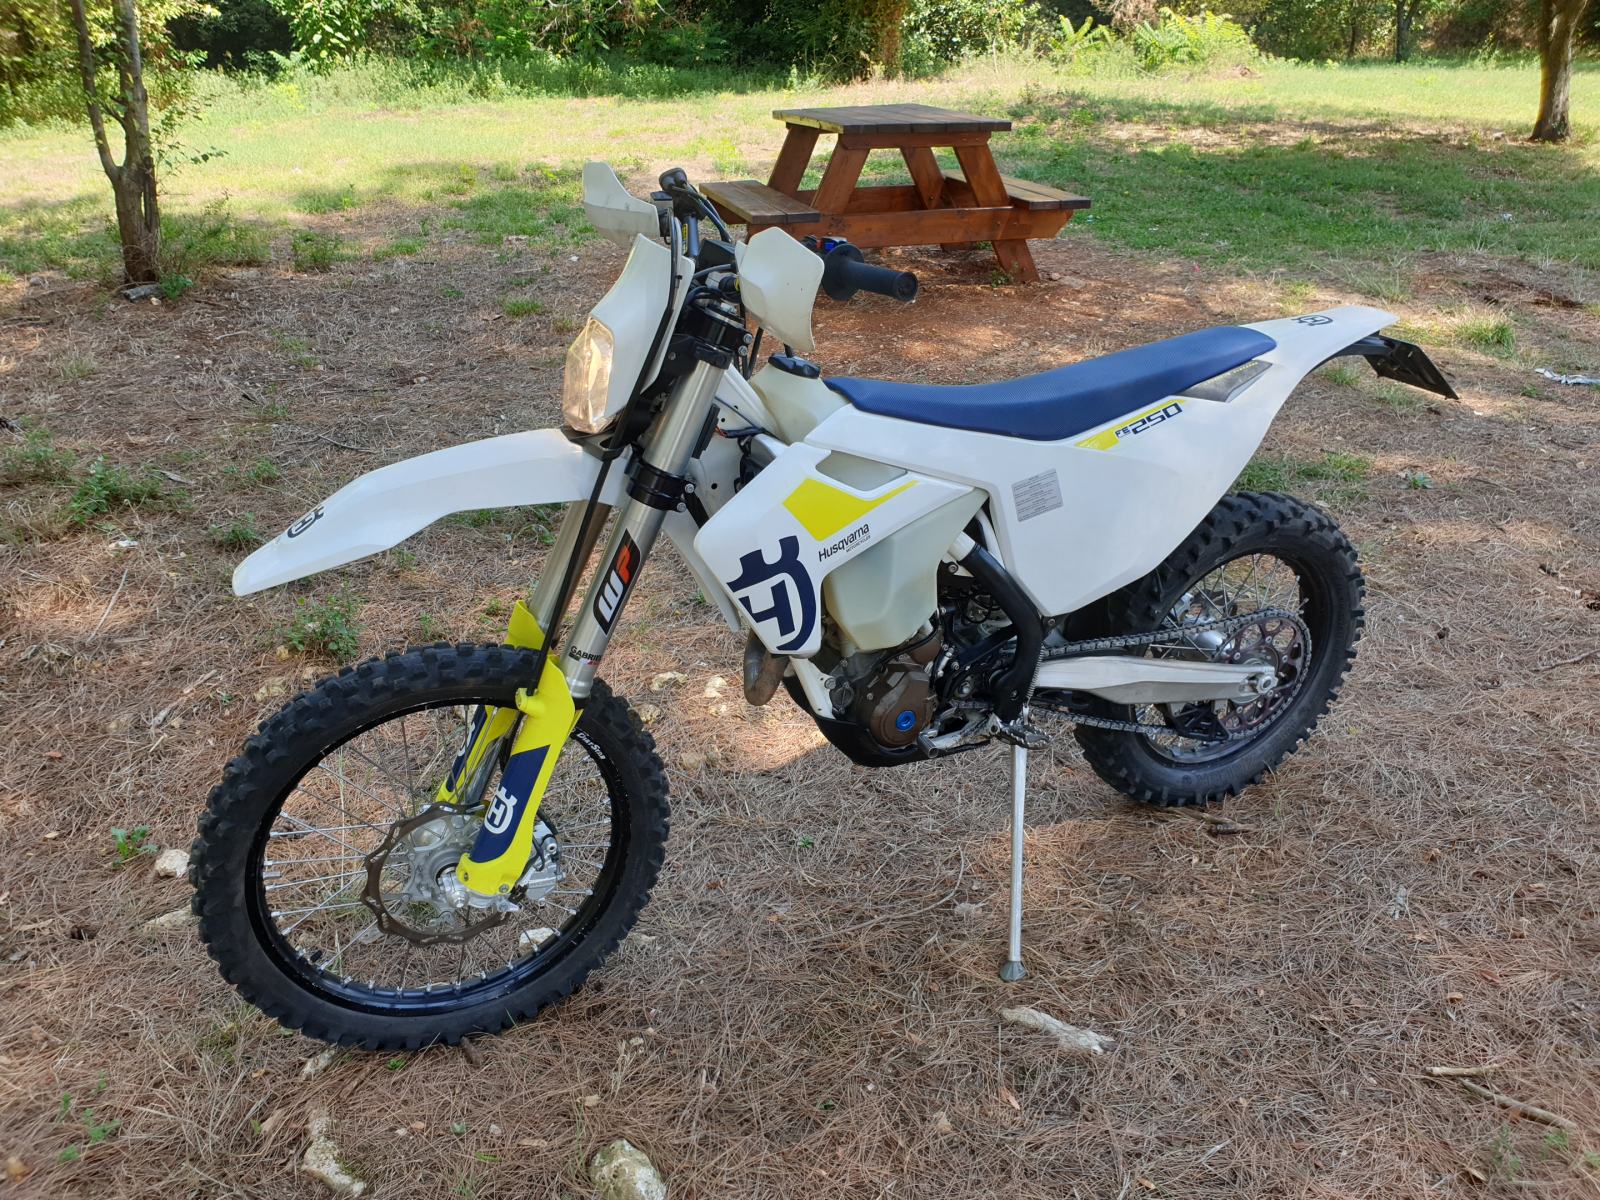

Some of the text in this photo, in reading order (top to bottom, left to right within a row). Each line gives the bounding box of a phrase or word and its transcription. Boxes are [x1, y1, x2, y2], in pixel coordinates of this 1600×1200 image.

[1115, 403, 1182, 438] FE 250
[818, 523, 870, 562] Husqvarna
